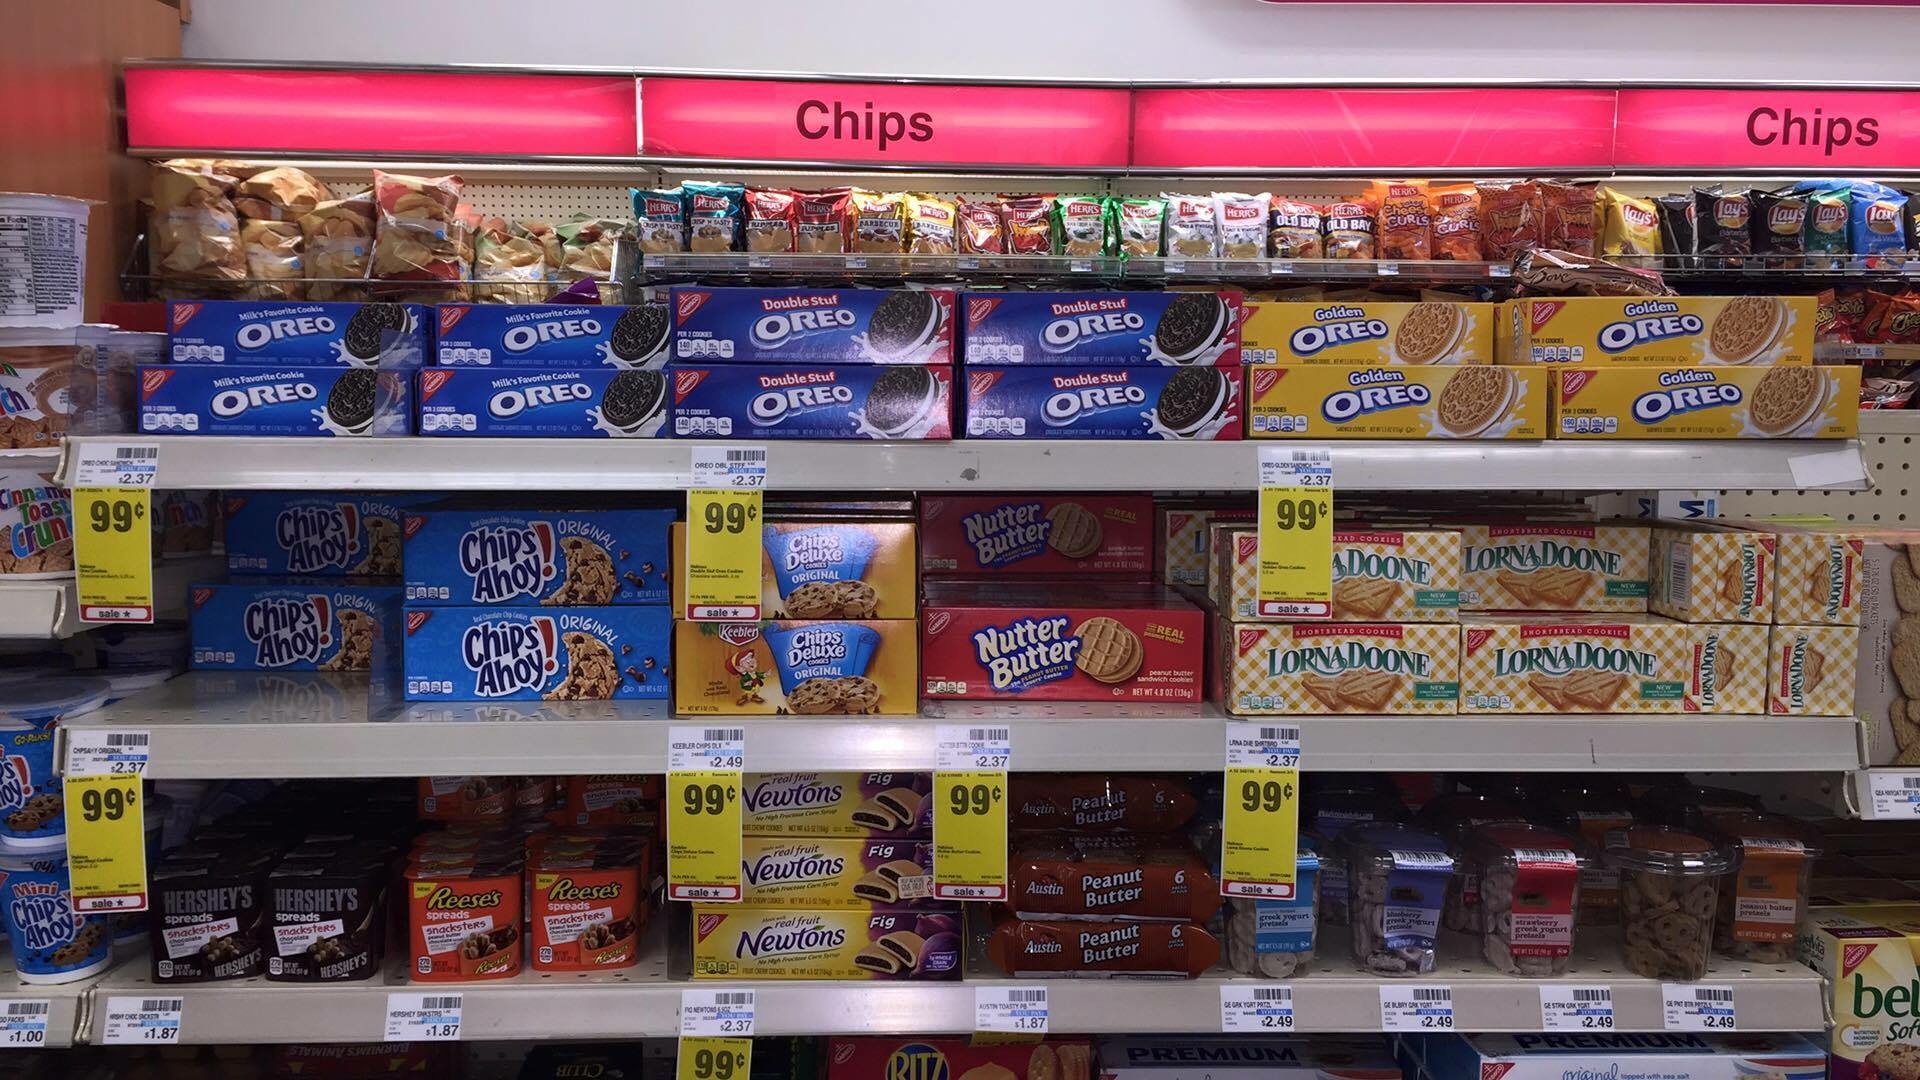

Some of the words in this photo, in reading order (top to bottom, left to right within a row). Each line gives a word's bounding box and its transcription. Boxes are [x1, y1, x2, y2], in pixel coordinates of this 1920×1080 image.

[796, 99, 933, 151] Chips
[1746, 106, 1879, 156] Chips
[649, 203, 679, 214] HERR'S
[1070, 202, 1100, 214] HERR'S
[1226, 207, 1258, 218] HERR'S
[1771, 205, 1805, 225] Lay's
[1815, 203, 1846, 222] Lay's
[1326, 219, 1348, 231] OLD
[1349, 219, 1372, 232] BAY
[1388, 215, 1430, 227] CURLS
[763, 296, 809, 310] Double
[809, 294, 839, 306] Stuf
[1052, 301, 1098, 315] Double
[1099, 298, 1127, 310] Stuf
[1625, 301, 1679, 317] Golden
[1315, 306, 1364, 321] Golden
[237, 316, 337, 349] OREO
[754, 309, 857, 341] OREO
[1043, 312, 1145, 345] OREO
[1598, 314, 1703, 353] OREO
[503, 318, 602, 352] OREO
[1291, 319, 1388, 355] OREO
[491, 377, 517, 389] Milk's
[517, 374, 552, 386] Favorite
[552, 371, 580, 380] Cookie
[760, 374, 807, 388] Double
[807, 371, 836, 384] Stuf
[1053, 374, 1099, 389] Double
[1100, 371, 1128, 384] Stuf
[1349, 369, 1404, 385] Golden
[1659, 370, 1716, 386] Golden
[211, 382, 318, 417] OREO
[489, 382, 593, 417] OREO
[752, 385, 854, 418] OREO
[1045, 385, 1146, 418] OREO
[1322, 383, 1431, 423] OREO
[1632, 384, 1742, 424] OREO
[118, 472, 154, 485] $2.37
[731, 475, 765, 487] $2.37
[1300, 475, 1331, 487] $2.37
[90, 500, 145, 533] 99¢
[705, 502, 757, 534] 99¢
[1276, 499, 1328, 531] 99¢
[557, 520, 618, 551] ORIGINAL
[789, 532, 840, 552] Chips
[461, 526, 536, 575] Chips
[785, 547, 844, 571] Deluxe
[1463, 544, 1541, 575] LORNA
[1539, 540, 1622, 577] DOONE
[791, 570, 841, 584] ORIGINAL
[98, 608, 120, 618] sale
[706, 607, 728, 617] sale
[1277, 603, 1299, 613] sale
[560, 614, 619, 646] ORIGINAL
[720, 625, 759, 639] Keebler
[1156, 625, 1185, 640] REAL
[1296, 627, 1356, 636] SHORTBREAD
[1364, 628, 1401, 636] COOKIES
[1522, 627, 1583, 636] SHORTBREAD
[1586, 628, 1628, 637] COOKIES
[464, 620, 540, 670] Chips
[791, 630, 842, 650] Chips
[973, 617, 1069, 664] Nutter
[788, 643, 846, 668] Deluxe
[988, 637, 1080, 690] Butter
[1267, 645, 1348, 678] LORNA
[1346, 642, 1431, 678] DOONE
[1494, 646, 1575, 678] LORNA
[1573, 641, 1658, 678] DOONE
[794, 667, 843, 680] ORIGINAL
[1149, 670, 1172, 679] peanut
[1173, 669, 1194, 677] butter
[1164, 688, 1174, 697] OZ
[110, 761, 146, 774] $2.37
[709, 756, 743, 769] $2.49
[975, 756, 1008, 768] $2.37
[1265, 755, 1299, 767] $2.37
[866, 773, 893, 785] Fig
[82, 787, 136, 822] 99¢
[684, 783, 736, 816] 99¢
[742, 782, 842, 812] Newtons
[950, 784, 1001, 816] 99¢
[1241, 780, 1293, 813] 99¢
[773, 846, 791, 857] real
[791, 843, 820, 857] fruit
[868, 844, 895, 859] Fig
[742, 855, 844, 885] Newtons
[1081, 868, 1144, 891] Peanut
[12, 882, 58, 899] Mini
[549, 879, 622, 901] Reese's
[1025, 881, 1065, 896] Austin
[1085, 886, 1144, 908] Butter
[1240, 884, 1262, 894] sale
[163, 884, 253, 914] HERSHEY'S
[273, 887, 359, 913] HERSHEY'S
[428, 887, 502, 910] Reese's
[275, 911, 321, 922] spreads
[426, 910, 470, 921] spreads
[1739, 903, 1768, 913] peanut
[1769, 903, 1794, 912] butter
[164, 912, 214, 924] spreads
[775, 917, 793, 929] real
[793, 915, 821, 929] fruit
[869, 915, 896, 929] Fig
[1259, 912, 1280, 922] greek
[1281, 912, 1310, 923] yogurt
[1515, 919, 1560, 929] strawberry
[1079, 924, 1141, 948] Peanut
[1515, 926, 1538, 936] greek
[1540, 927, 1568, 937] yogurt
[736, 926, 846, 960] Newtons
[766, 957, 781, 966] High
[782, 955, 806, 963] Fructose
[1083, 942, 1141, 964] Butter
[720, 1020, 752, 1032] $2.37
[1015, 1017, 1046, 1029] $1.87
[1261, 1015, 1294, 1028] $2.49
[1421, 1015, 1454, 1028] $2.49
[1581, 1016, 1613, 1029] $2.49
[1703, 1015, 1735, 1028] $2.49
[9, 1029, 44, 1042] $1.00
[144, 1027, 179, 1040] $1.87
[426, 1024, 459, 1037] $1.87
[694, 1049, 745, 1080] 99¢
[1126, 1046, 1297, 1067] PREMIUM
[890, 1051, 945, 1080] RITZ
[1562, 1062, 1619, 1080] original
